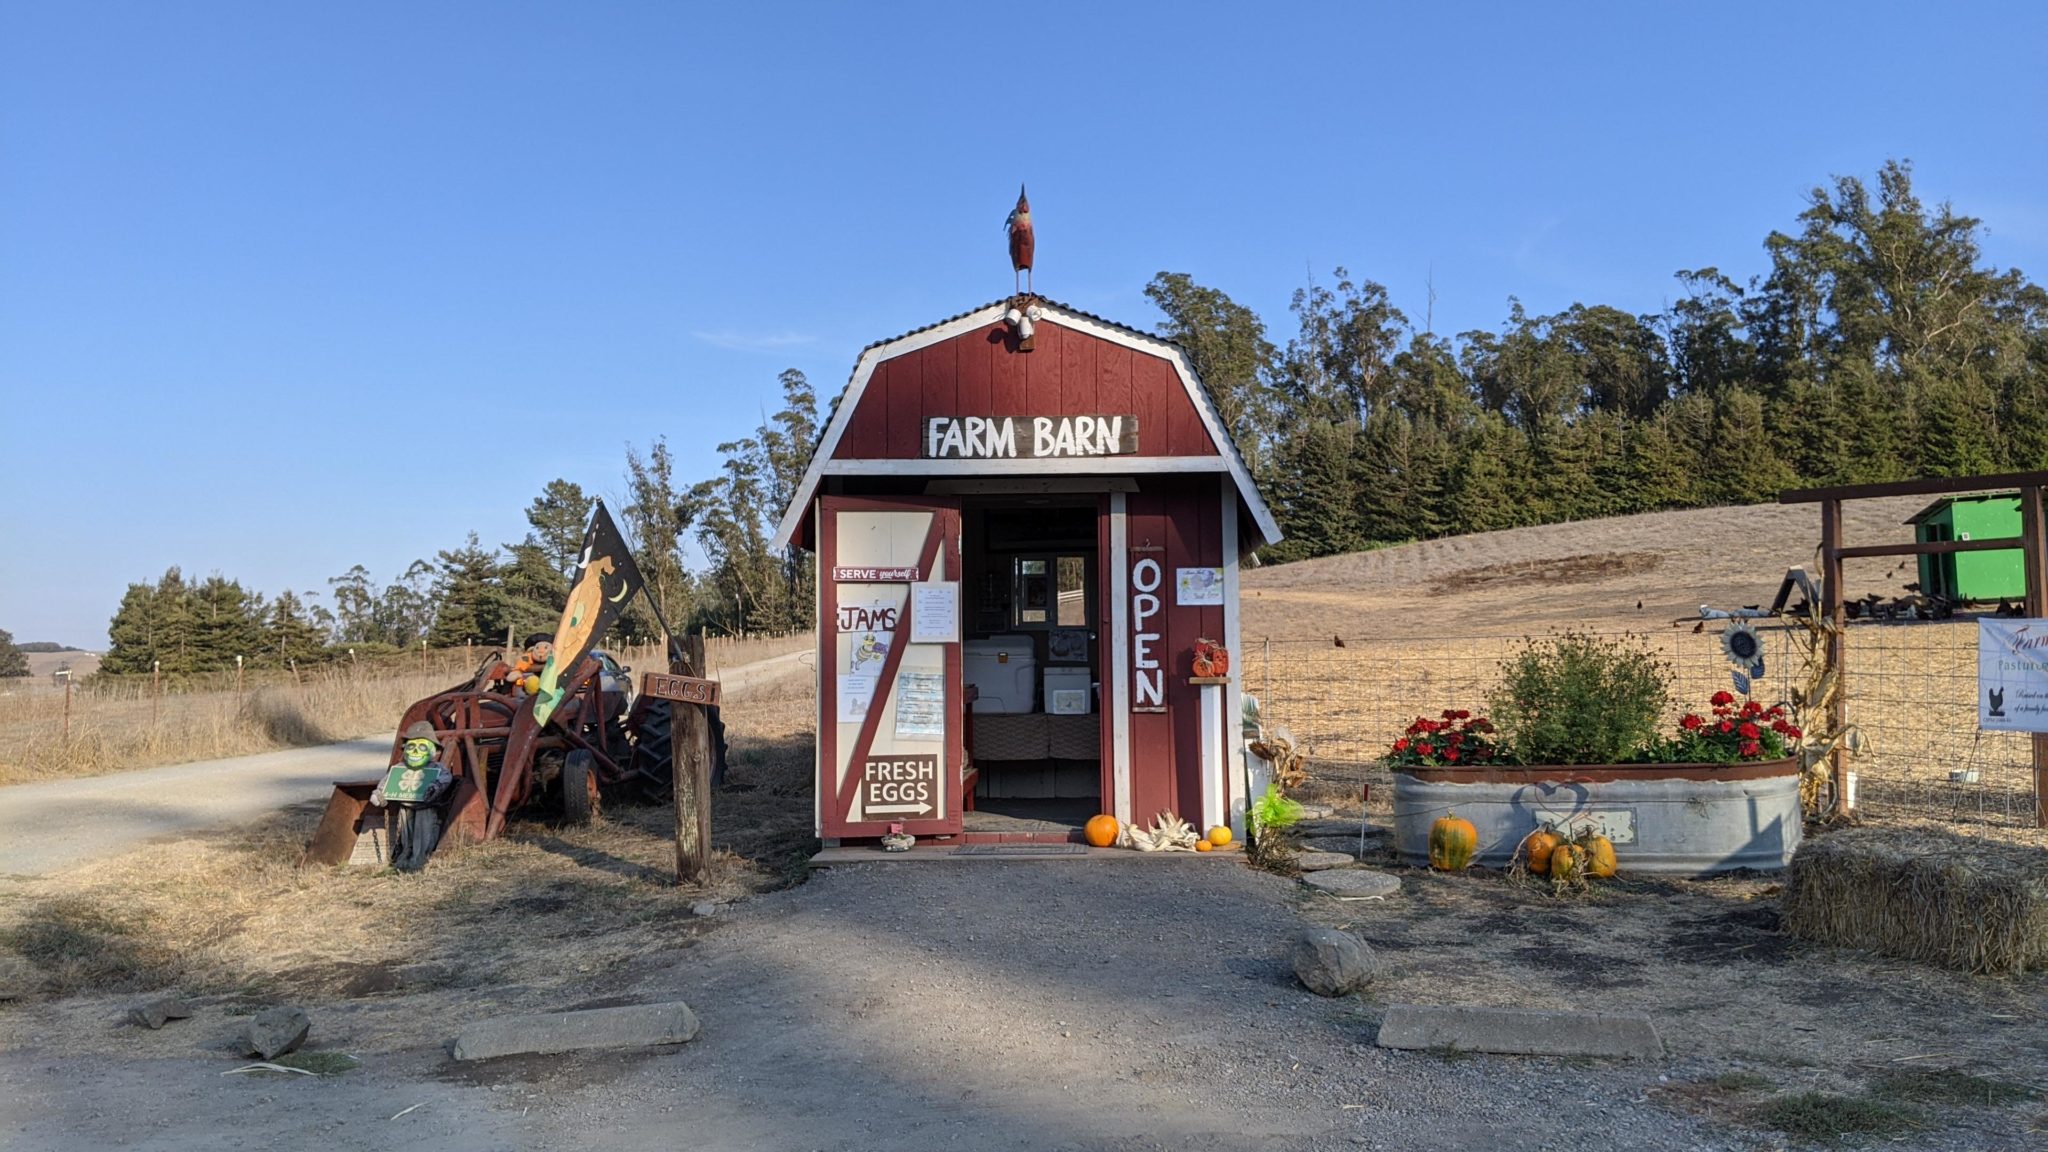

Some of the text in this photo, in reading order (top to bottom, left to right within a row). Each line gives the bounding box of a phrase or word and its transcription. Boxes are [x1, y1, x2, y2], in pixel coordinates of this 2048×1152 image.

[928, 415, 1122, 458] FARM BARN
[839, 569, 911, 580] SERVE yourself
[840, 607, 897, 631] JAMS
[1132, 558, 1163, 705] OPEN
[655, 677, 707, 702] EGGS
[865, 760, 933, 781] FRESH
[870, 782, 929, 802] EGGS
